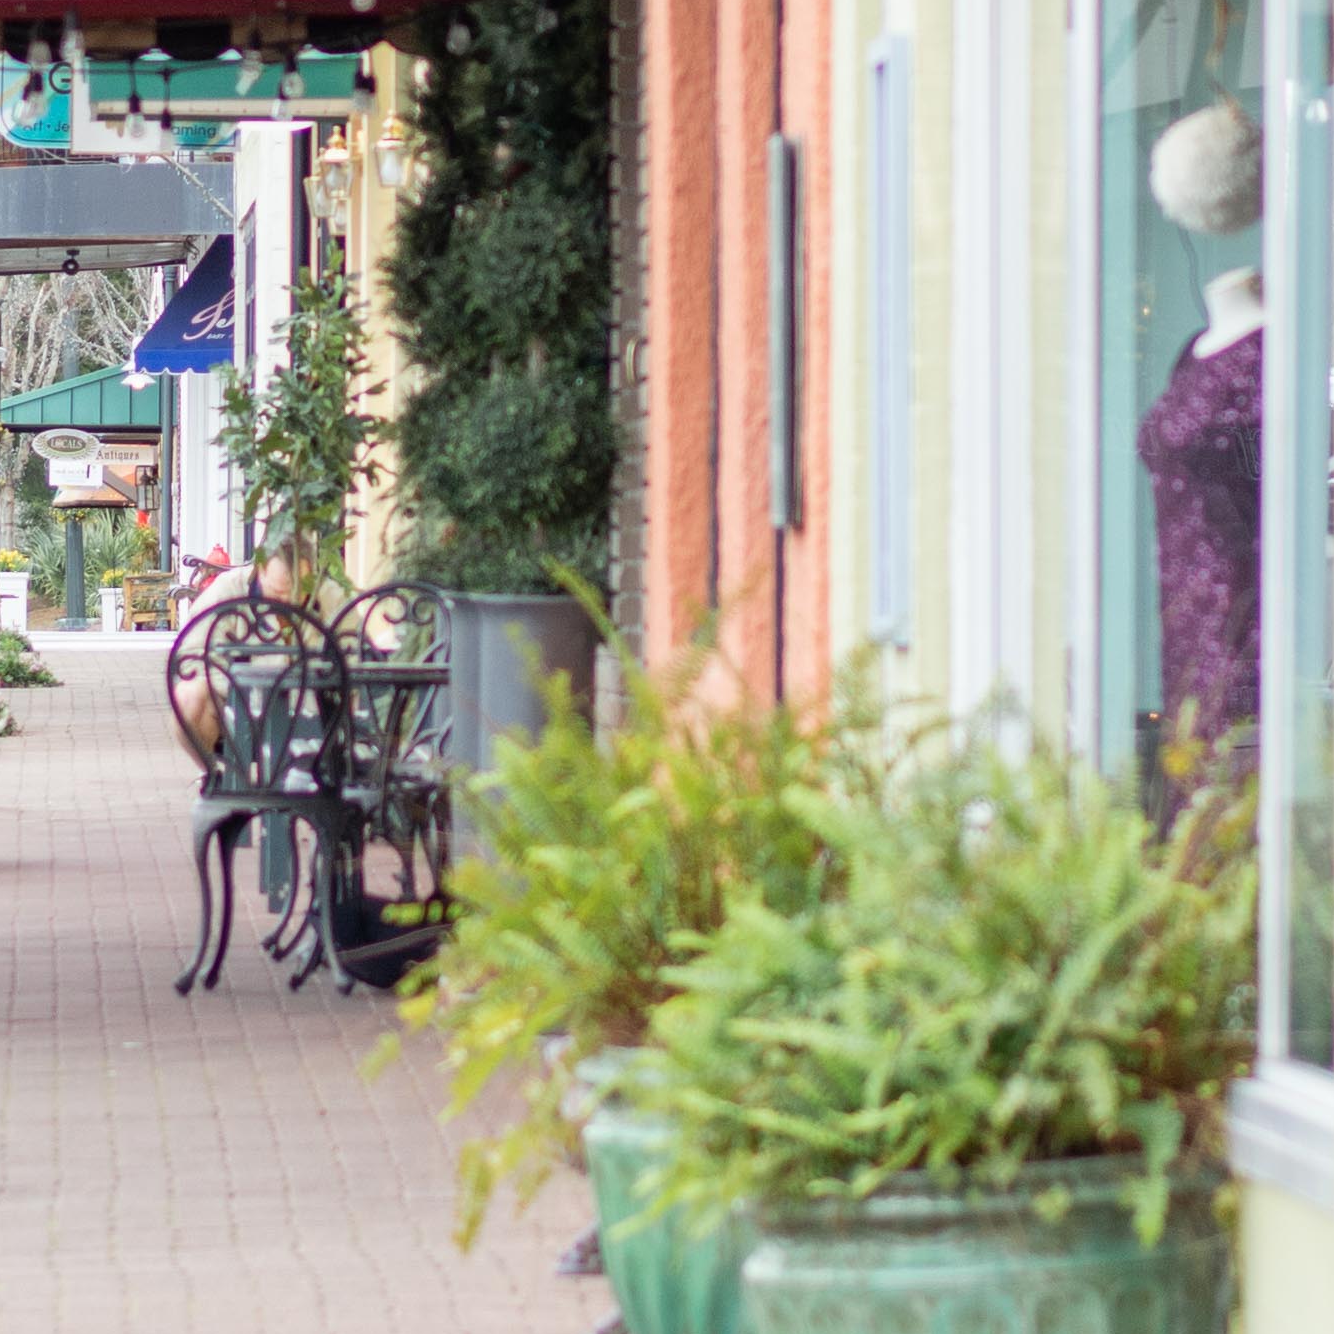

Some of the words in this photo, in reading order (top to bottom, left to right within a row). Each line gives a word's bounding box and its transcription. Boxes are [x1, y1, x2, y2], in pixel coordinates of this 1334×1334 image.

[170, 124, 217, 140] aming
[50, 438, 84, 449] LOCALS
[96, 450, 139, 462] Antiques
